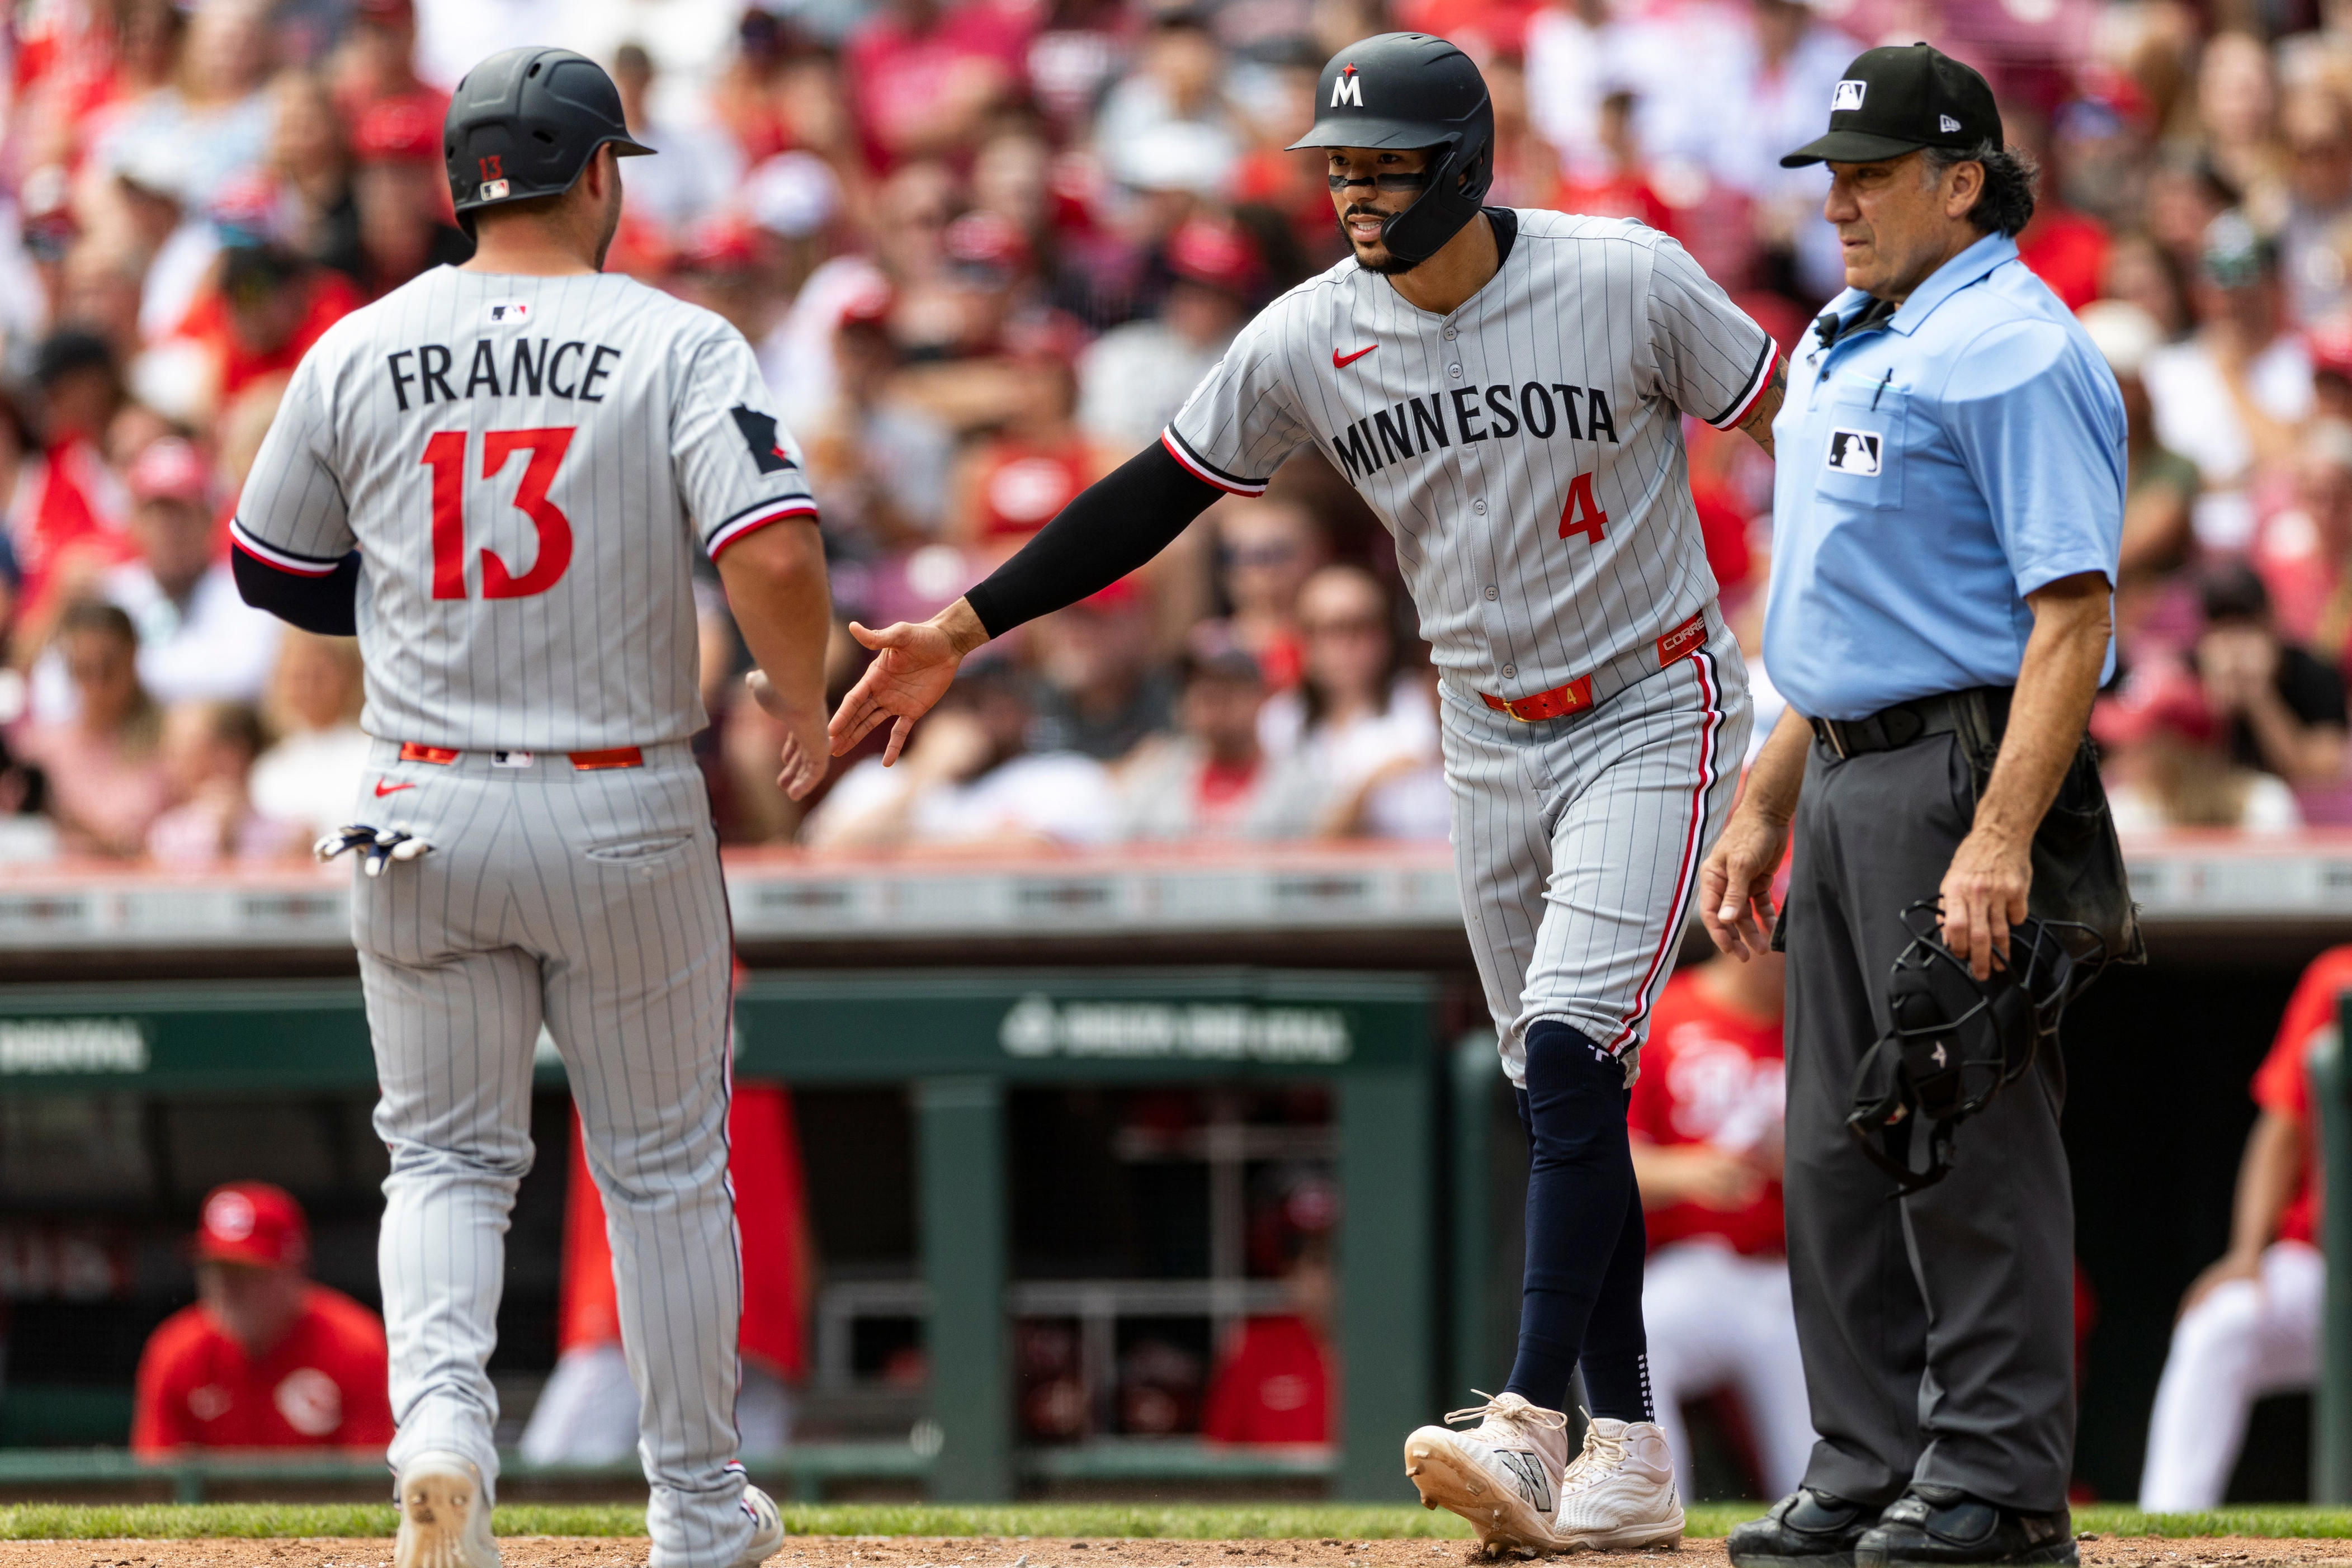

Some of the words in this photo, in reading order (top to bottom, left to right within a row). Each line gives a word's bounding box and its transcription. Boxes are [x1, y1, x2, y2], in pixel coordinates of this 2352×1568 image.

[1330, 76, 1363, 107] M
[479, 155, 502, 181] 13
[388, 338, 621, 411] FRANCE
[1332, 381, 1619, 487] MINNESOTA
[419, 426, 577, 600] 13
[1558, 472, 1607, 545] 4
[1663, 616, 1705, 650] CORRE
[1566, 687, 1577, 705] 4
